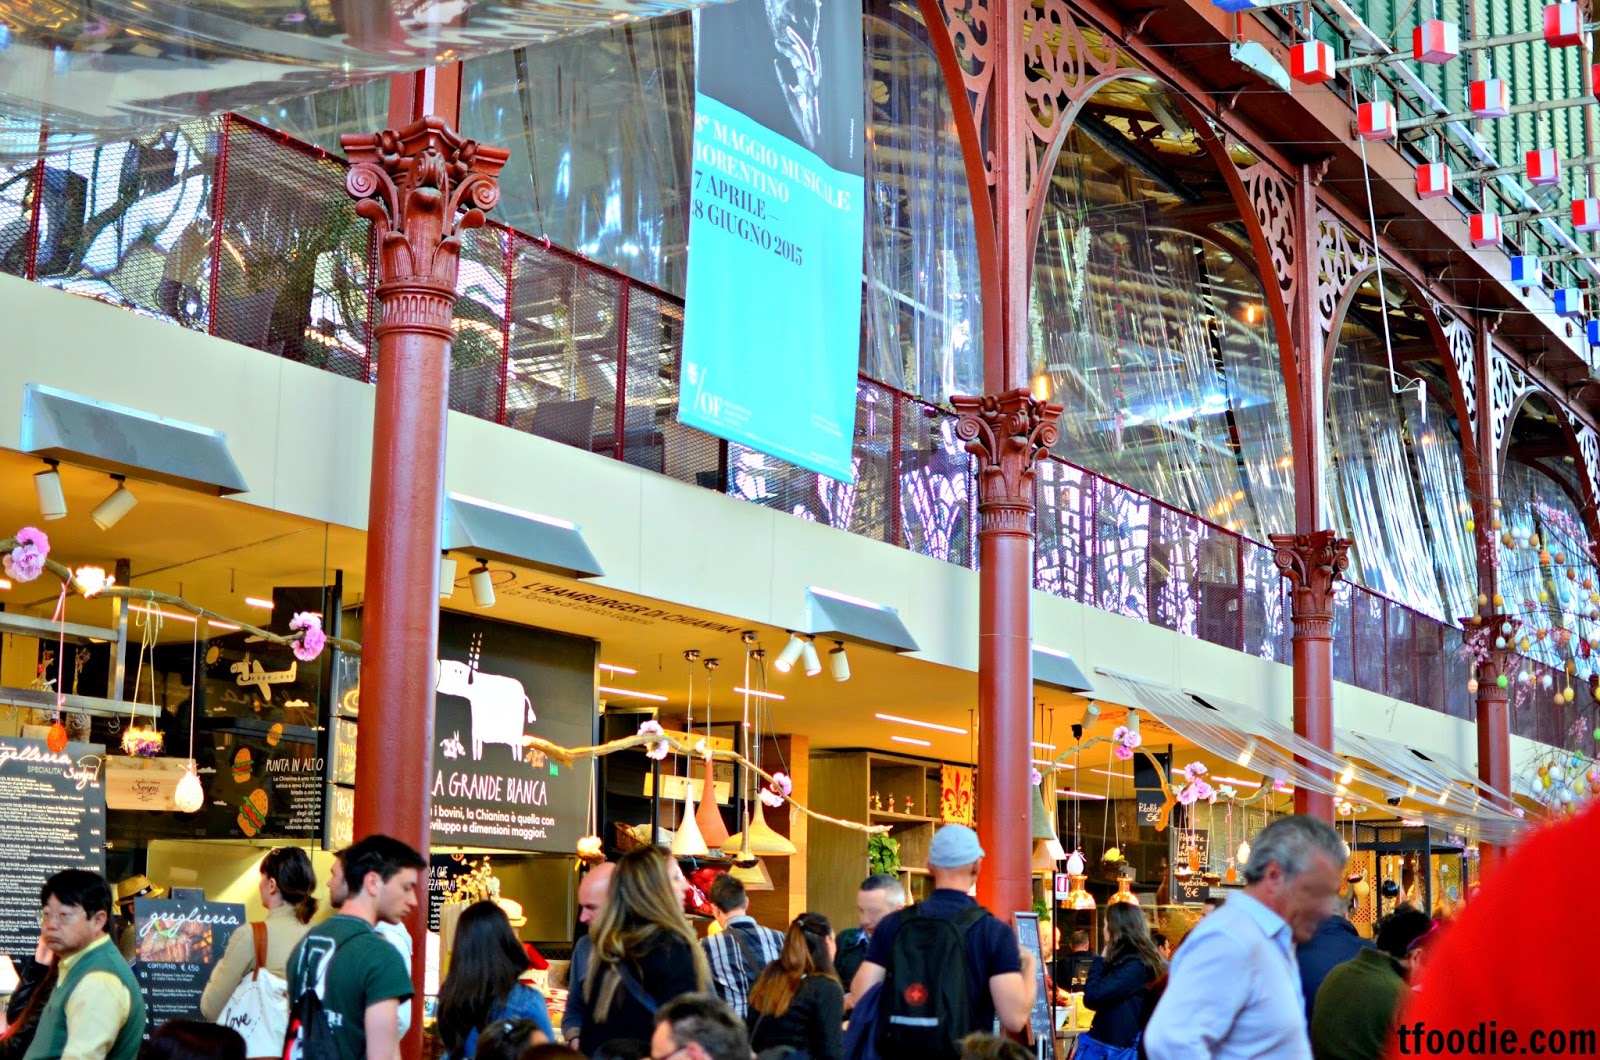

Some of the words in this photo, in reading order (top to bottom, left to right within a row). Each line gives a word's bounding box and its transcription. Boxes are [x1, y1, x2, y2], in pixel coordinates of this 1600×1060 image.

[714, 120, 778, 170] MAGGIO
[781, 154, 850, 211] MUSICALE
[706, 175, 766, 220] APRILE
[708, 203, 771, 250] GIUGNO
[774, 235, 802, 266] 2015
[522, 582, 650, 613] L'HAMBURGER
[643, 608, 668, 618] DI
[662, 613, 740, 633] CHIANINA
[27, 766, 62, 775] SPECIALITA'
[266, 758, 289, 772] PUNTA
[292, 758, 300, 772] IN
[302, 758, 324, 772] ALTO
[448, 771, 503, 801] GRANDE
[506, 777, 548, 806] BIANCA
[439, 804, 465, 820] bovini,
[467, 807, 475, 819] la
[476, 808, 510, 823] Chianina
[517, 813, 540, 826] quella
[541, 817, 555, 826] con
[462, 823, 468, 832] e
[469, 822, 510, 836] dimensioni
[511, 826, 547, 840] maggiori.
[1185, 887, 1199, 898] 8€
[140, 904, 239, 937] griglieria
